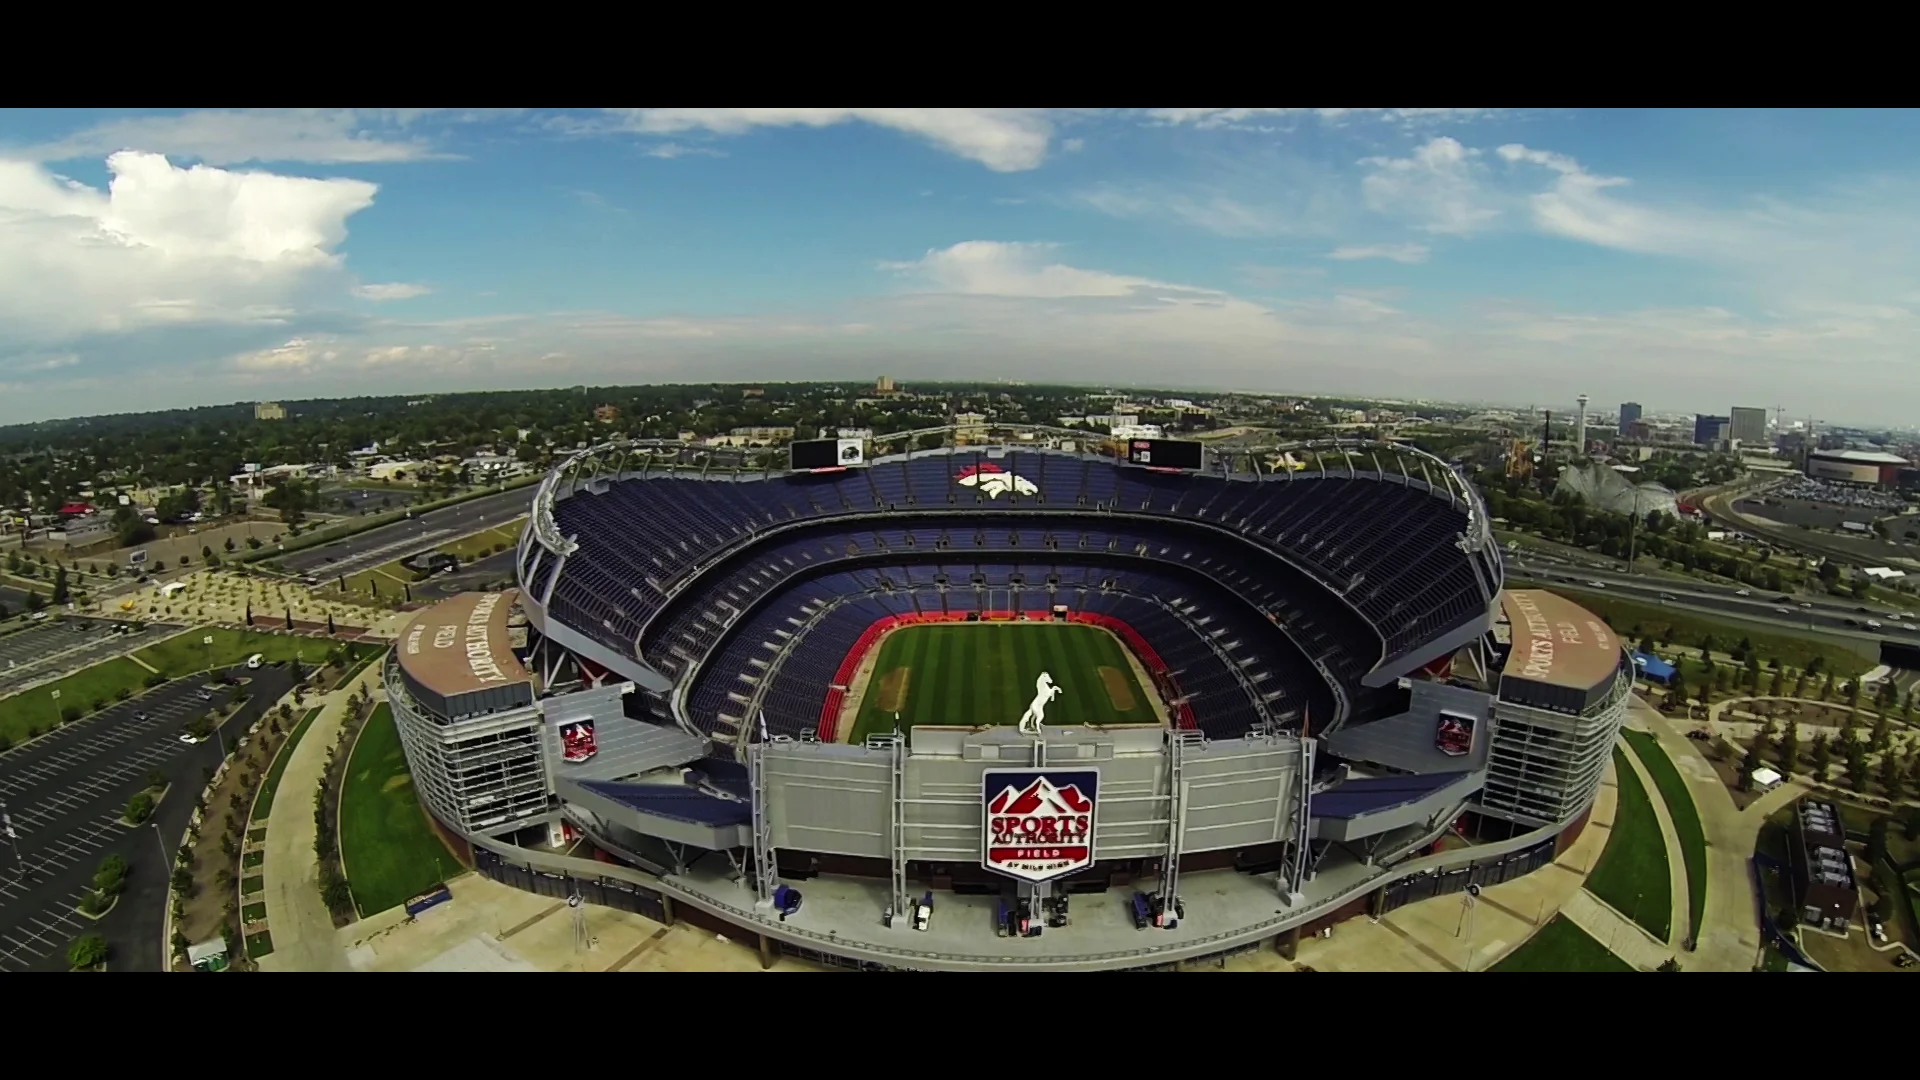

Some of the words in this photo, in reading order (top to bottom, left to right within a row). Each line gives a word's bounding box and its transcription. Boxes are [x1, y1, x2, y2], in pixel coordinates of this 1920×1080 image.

[991, 815, 1089, 834] SPORTS
[992, 832, 1087, 845] AUTHORITY
[1017, 849, 1061, 858] FIELD
